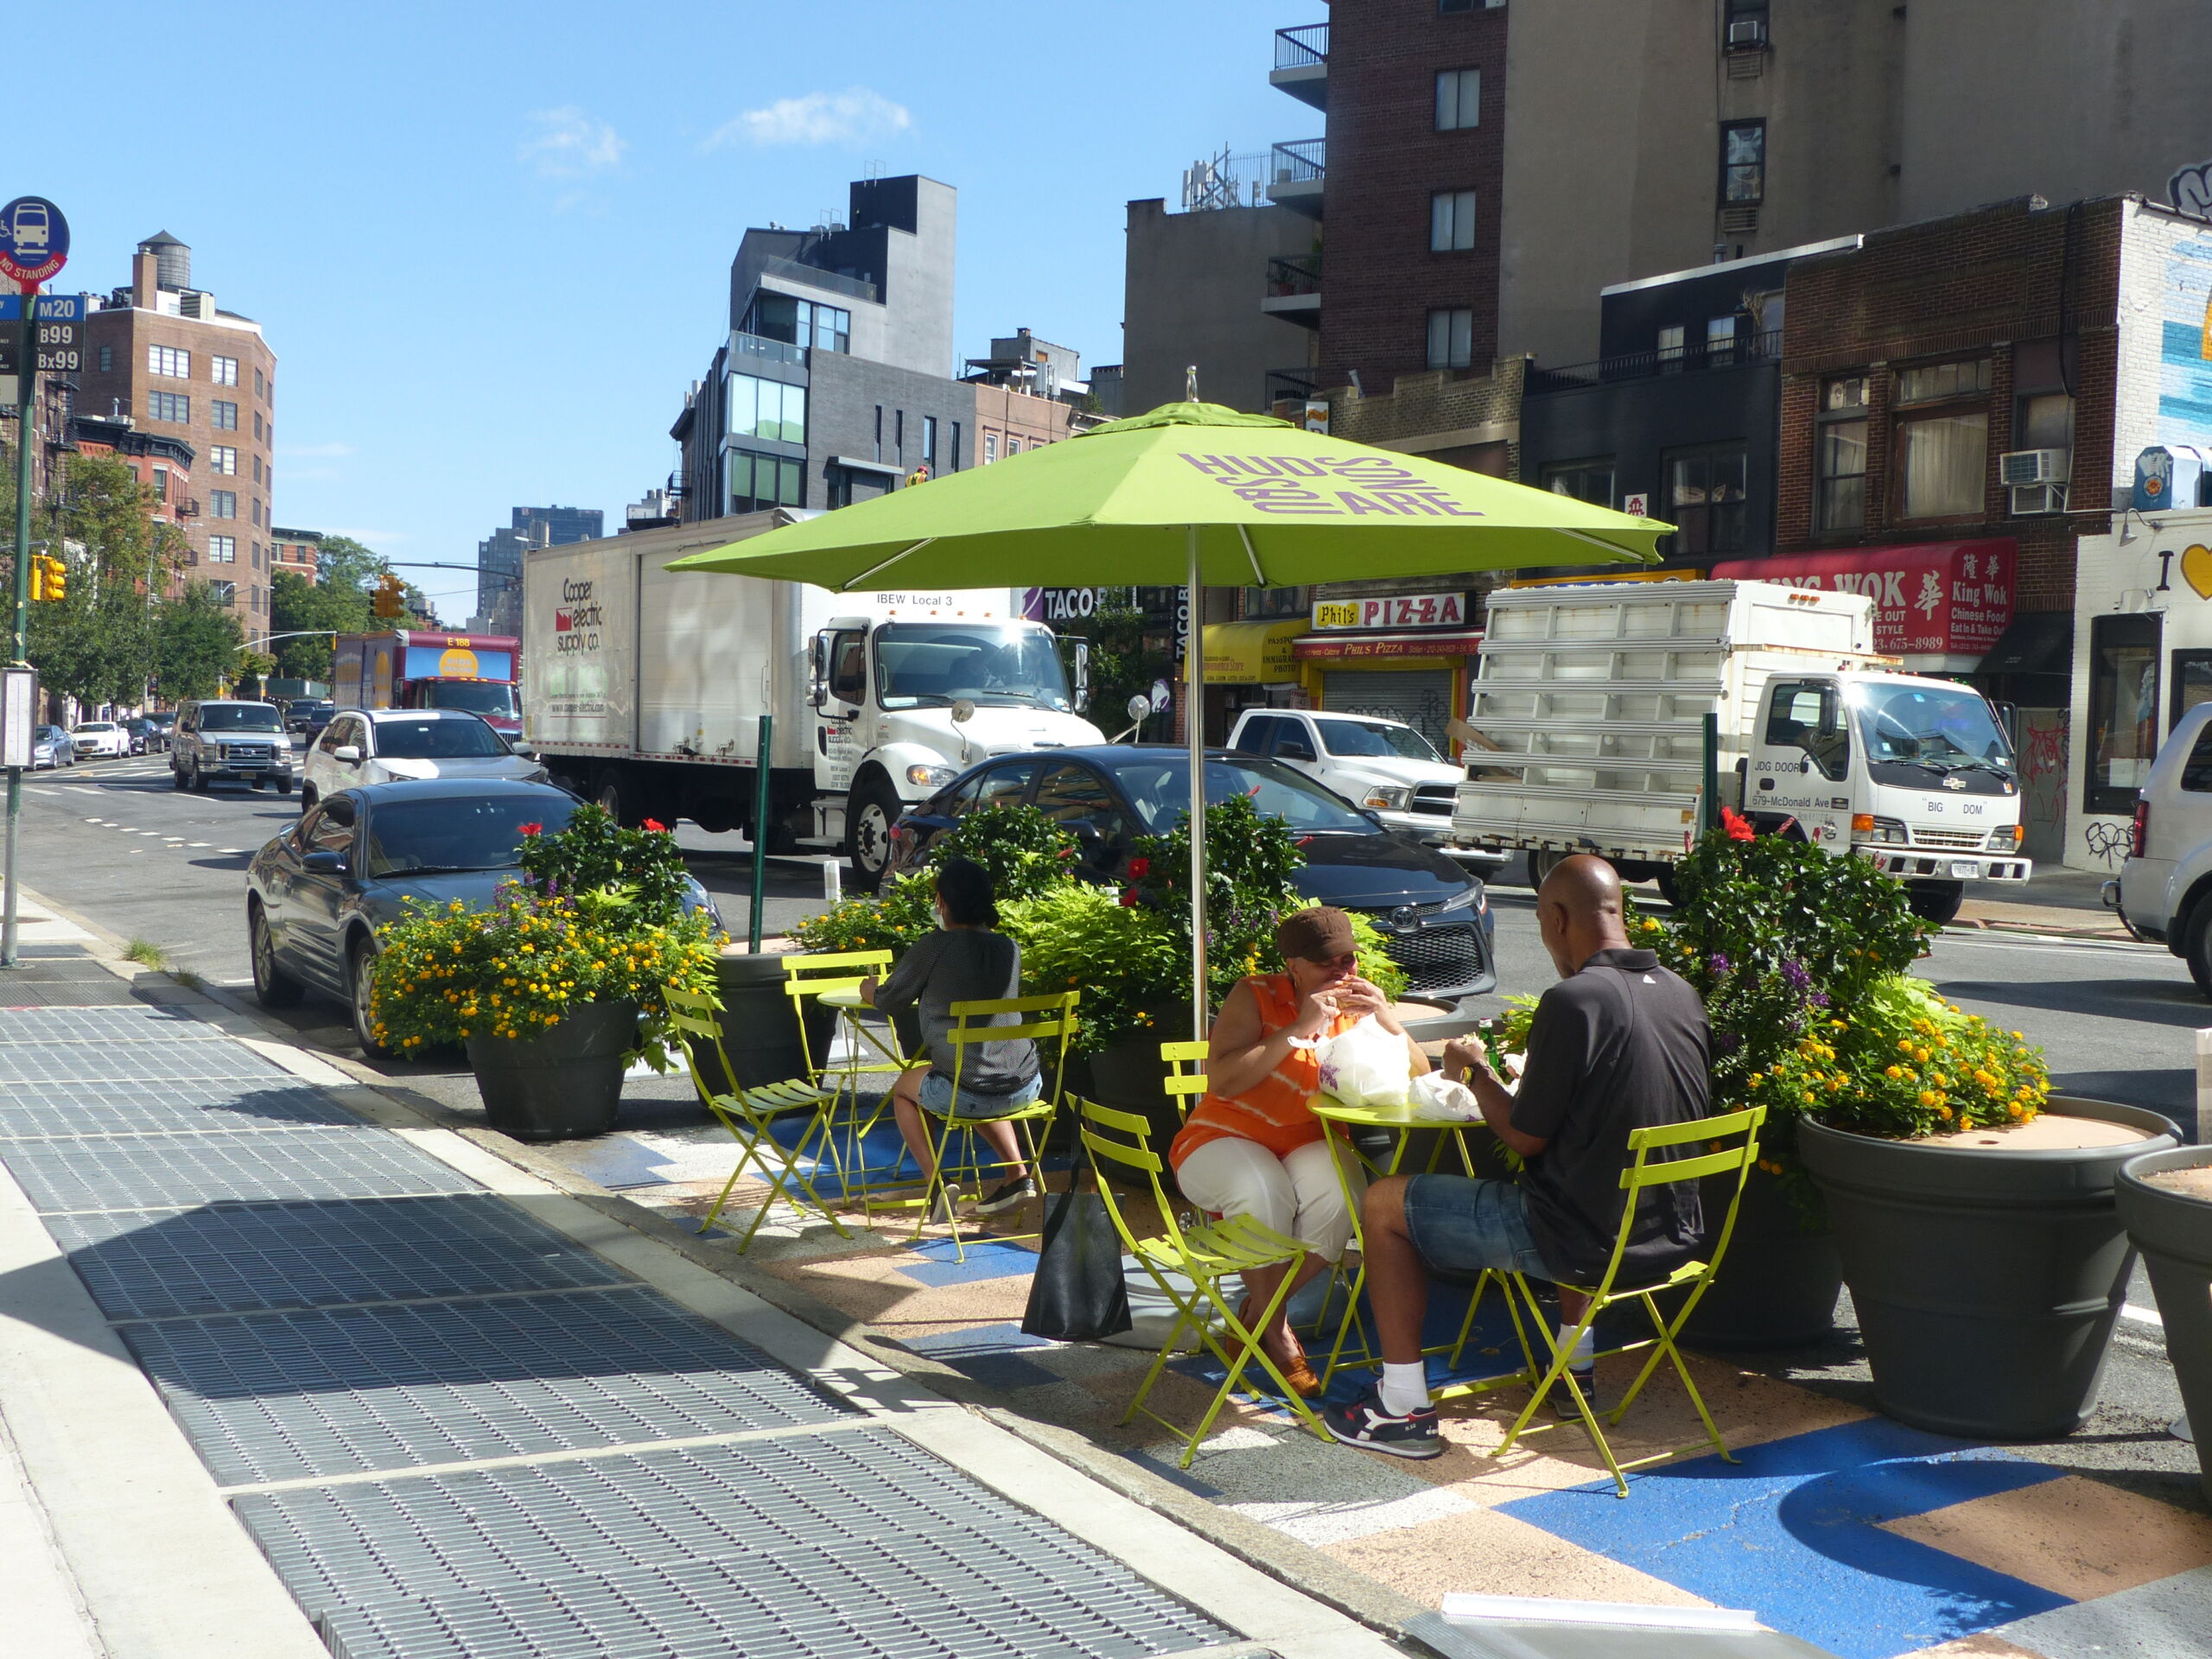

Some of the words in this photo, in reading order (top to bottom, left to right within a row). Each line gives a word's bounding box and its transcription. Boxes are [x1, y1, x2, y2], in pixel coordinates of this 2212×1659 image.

[0, 257, 13, 271] NO
[14, 259, 60, 279] STANDING
[40, 300, 75, 318] M20
[40, 326, 73, 344] B99
[38, 351, 79, 370] Bx99
[2156, 550, 2175, 591] I
[563, 577, 594, 604] Cooper
[1834, 571, 1906, 607] WOK
[1914, 570, 1944, 620] 華
[1953, 581, 1980, 607] King
[1984, 583, 2007, 605] Wok
[877, 594, 906, 604] IBEW
[912, 595, 941, 606] Local
[945, 596, 952, 606] 3
[1045, 588, 1093, 620] TACO
[573, 601, 602, 628] electric
[1321, 605, 1355, 624] Phil's
[1363, 596, 1461, 626] PIZZA
[1885, 610, 1906, 621] OUT
[1951, 607, 1984, 621] Chinese
[1986, 610, 2005, 623] Food
[1876, 625, 1904, 635] STYLE
[1951, 622, 1962, 632] Eat
[1978, 624, 1992, 635] Take
[447, 638, 454, 646] E
[557, 632, 586, 656] supply
[1268, 636, 1294, 645] PASSPO
[1344, 643, 1371, 655] PHIL'S
[1375, 642, 1404, 654] PIZZA
[1274, 664, 1297, 673] PHOTO
[1755, 761, 1771, 772] JDG
[1752, 796, 1811, 807] 679-McDonald
[1815, 798, 1829, 808] Ave
